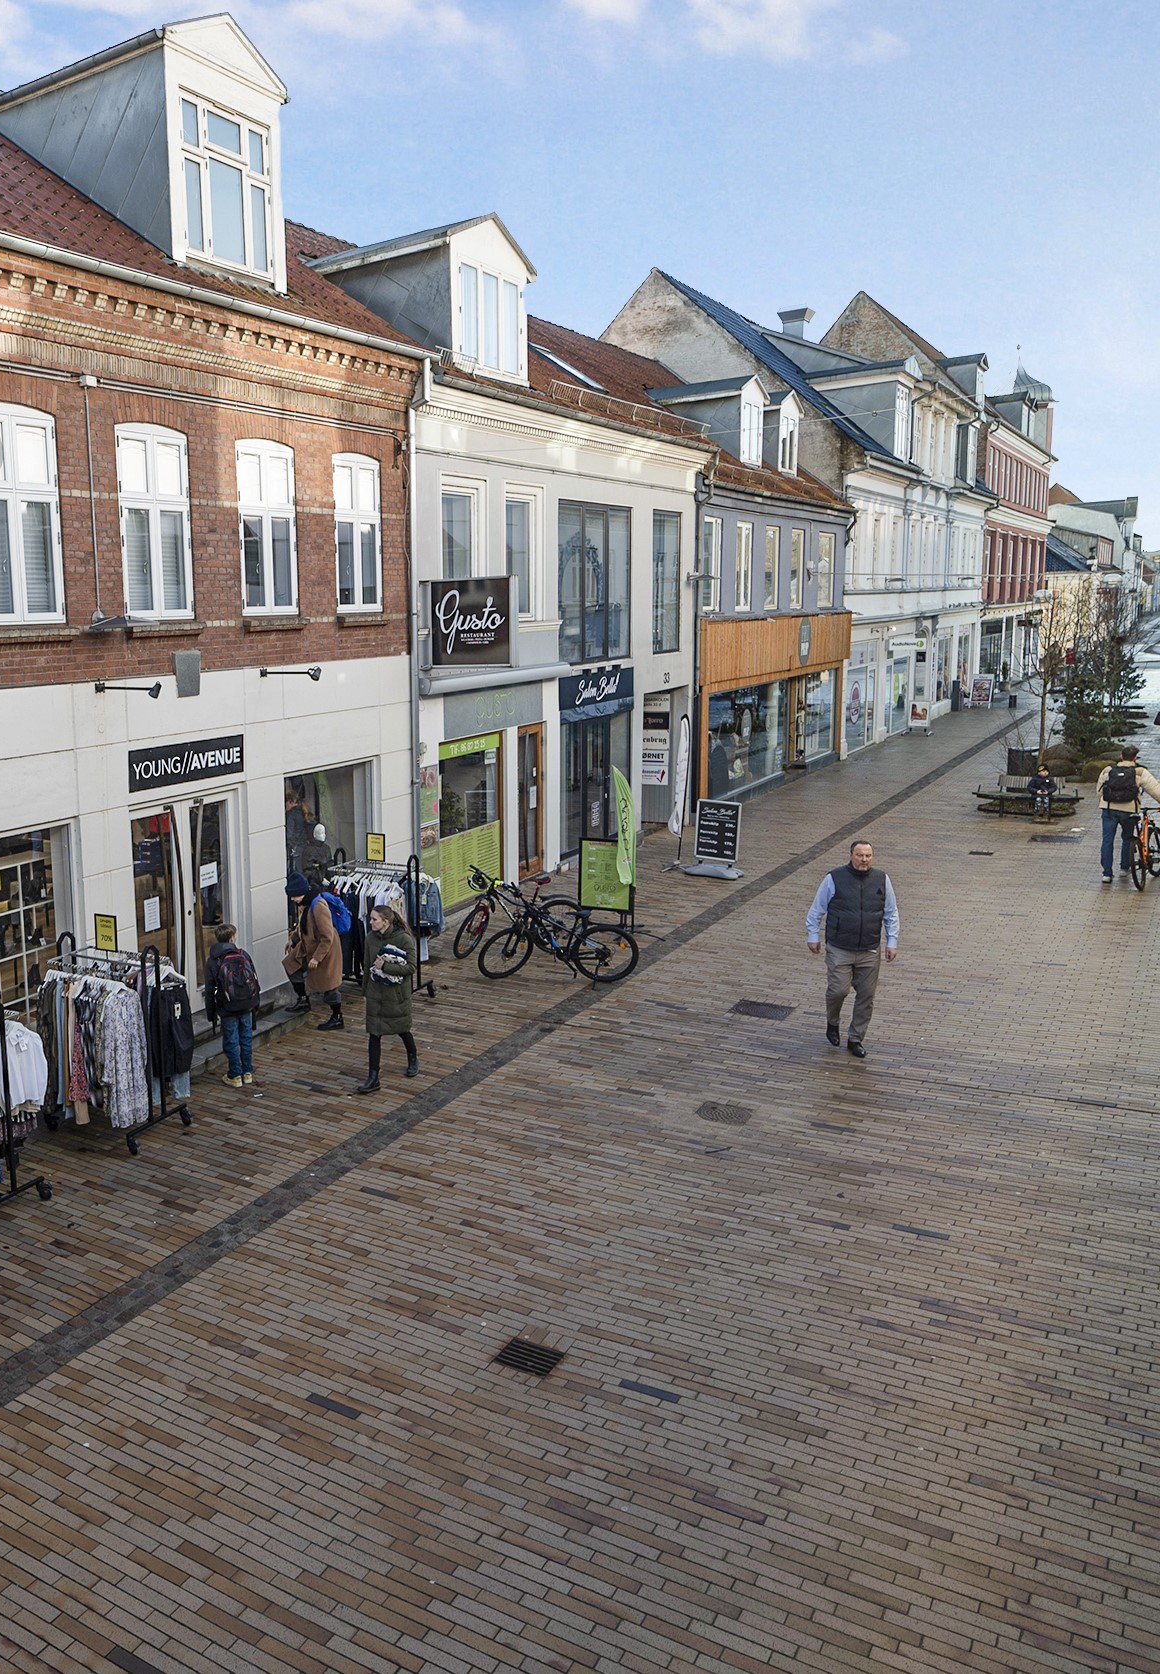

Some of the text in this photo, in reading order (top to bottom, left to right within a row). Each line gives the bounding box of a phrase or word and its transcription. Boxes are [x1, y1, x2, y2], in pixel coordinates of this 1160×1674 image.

[435, 589, 505, 655] Gusto
[663, 672, 671, 684] 33
[575, 679, 597, 705] Salon
[100, 934, 113, 943] 70%
